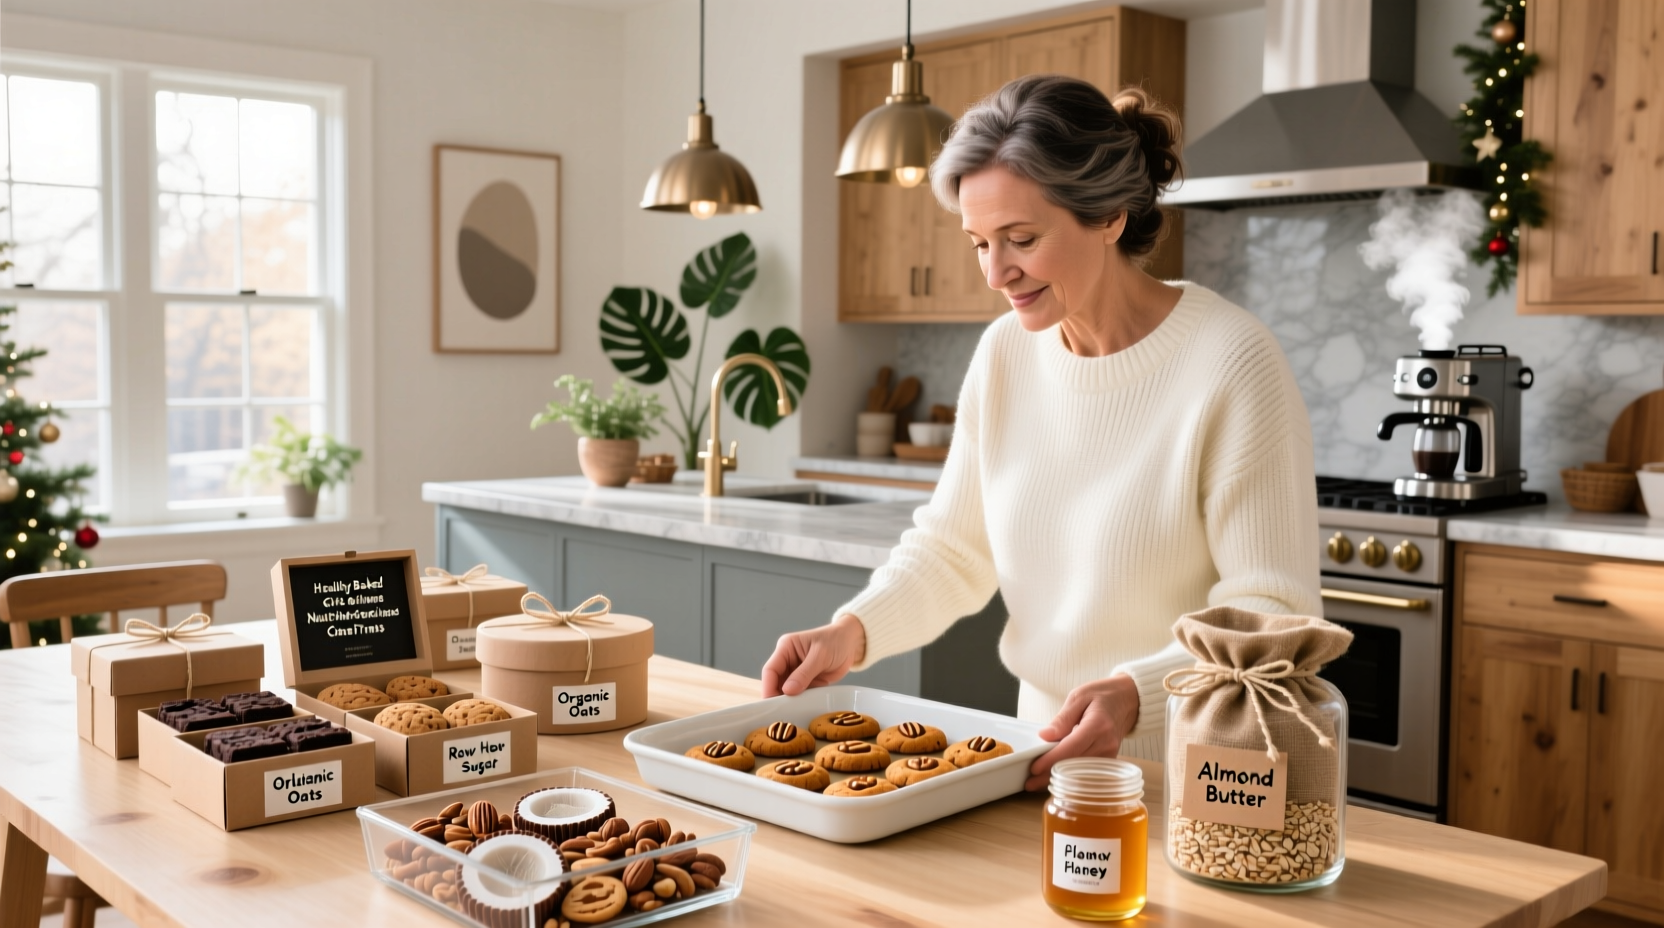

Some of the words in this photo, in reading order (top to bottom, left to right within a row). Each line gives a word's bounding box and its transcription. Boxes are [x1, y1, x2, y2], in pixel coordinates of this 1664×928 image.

[353, 575, 384, 591] Baked
[558, 689, 609, 706] Organic
[1198, 761, 1274, 787] Almond
[288, 789, 322, 804] Oats
[1206, 784, 1267, 808] Butter
